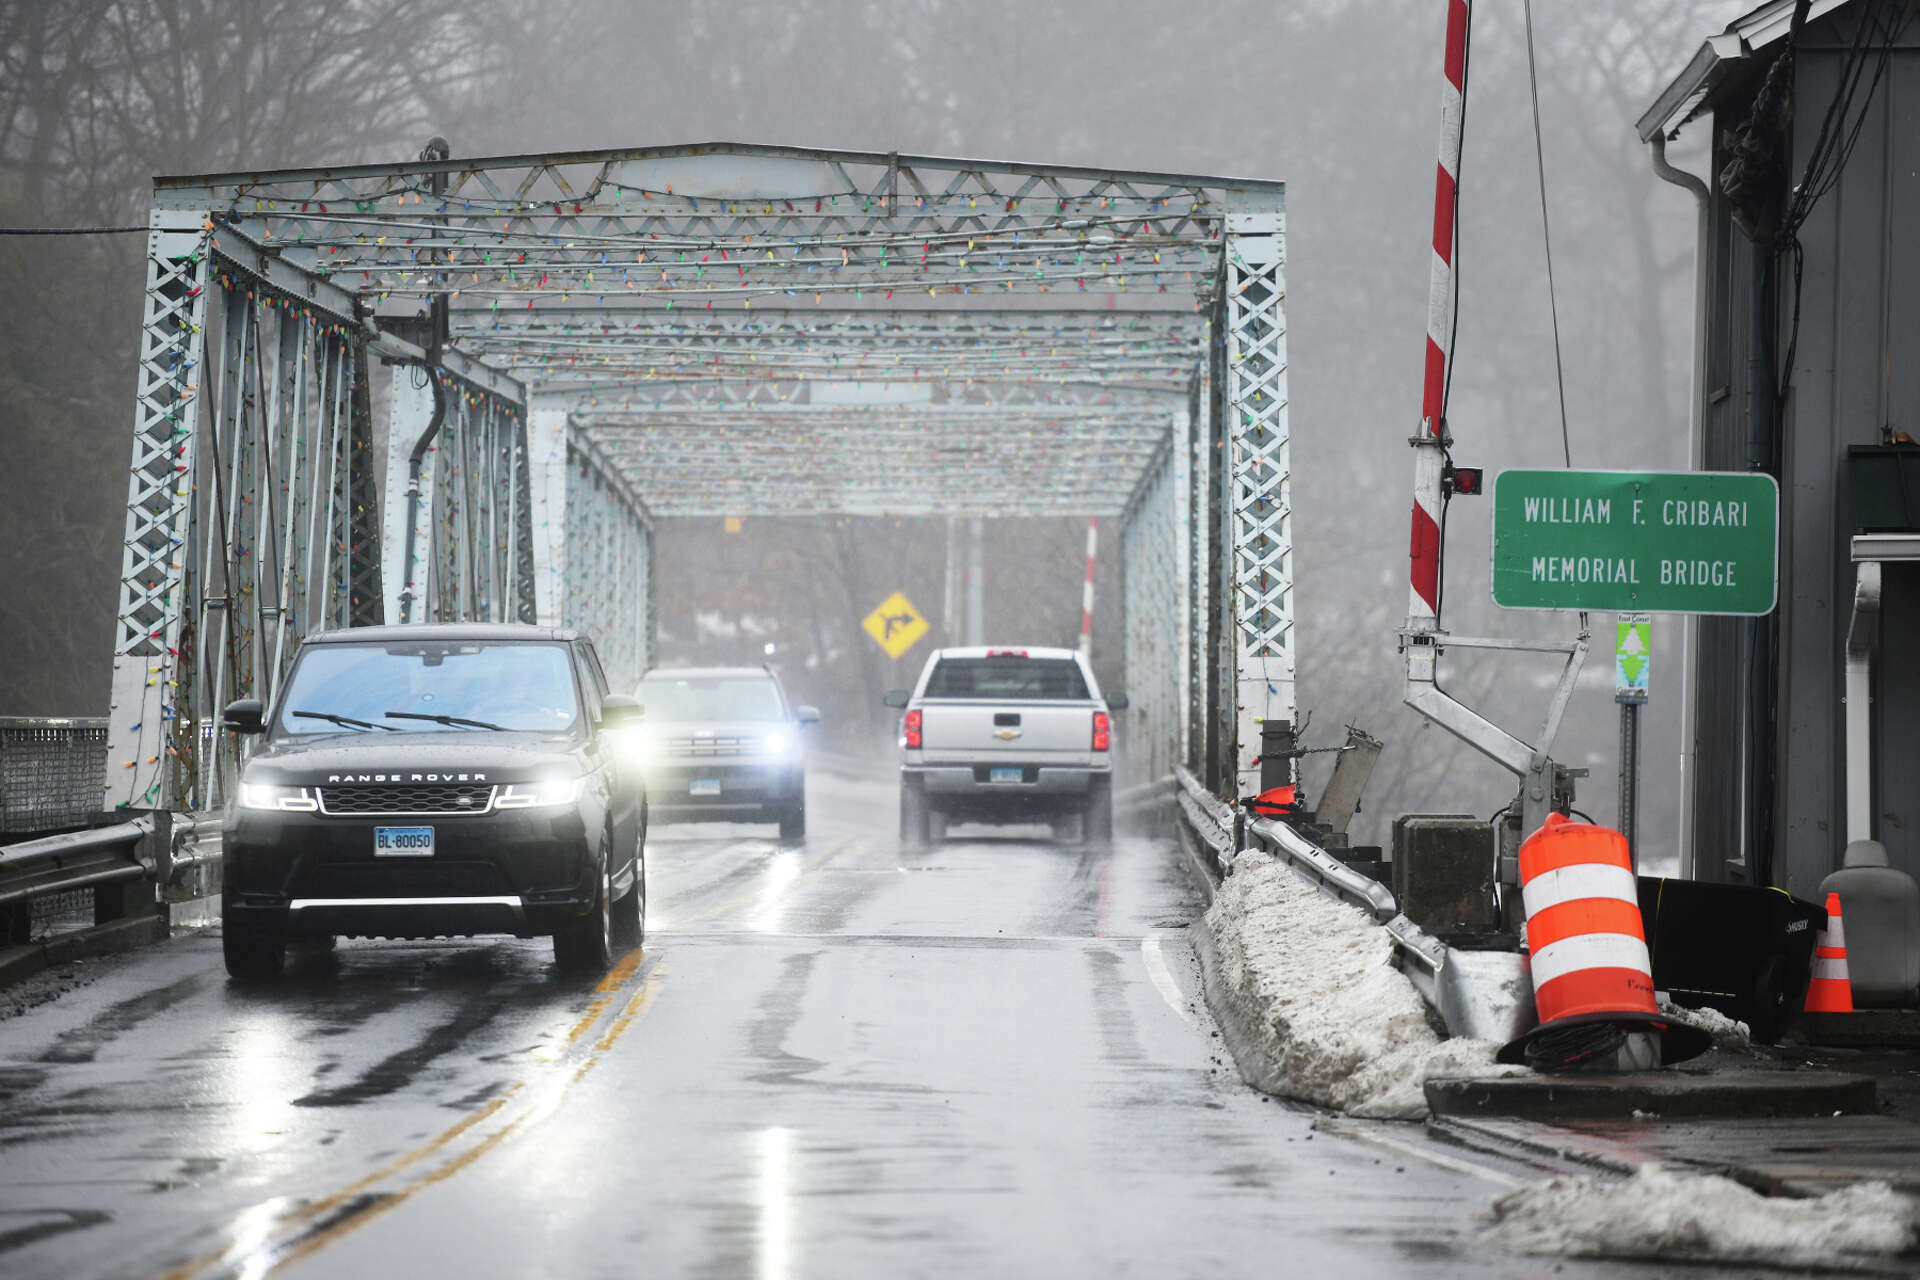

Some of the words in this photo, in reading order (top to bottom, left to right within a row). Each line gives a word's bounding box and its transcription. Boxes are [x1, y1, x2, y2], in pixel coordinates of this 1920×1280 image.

[1524, 497, 1611, 524] WILLIAM
[1633, 500, 1646, 525] F.
[1663, 500, 1747, 527] CRIBARI
[1532, 557, 1640, 584] MEMORIAL
[1661, 560, 1737, 586] BRIDGE
[328, 774, 402, 783] RANGE
[411, 773, 487, 782] ROVER
